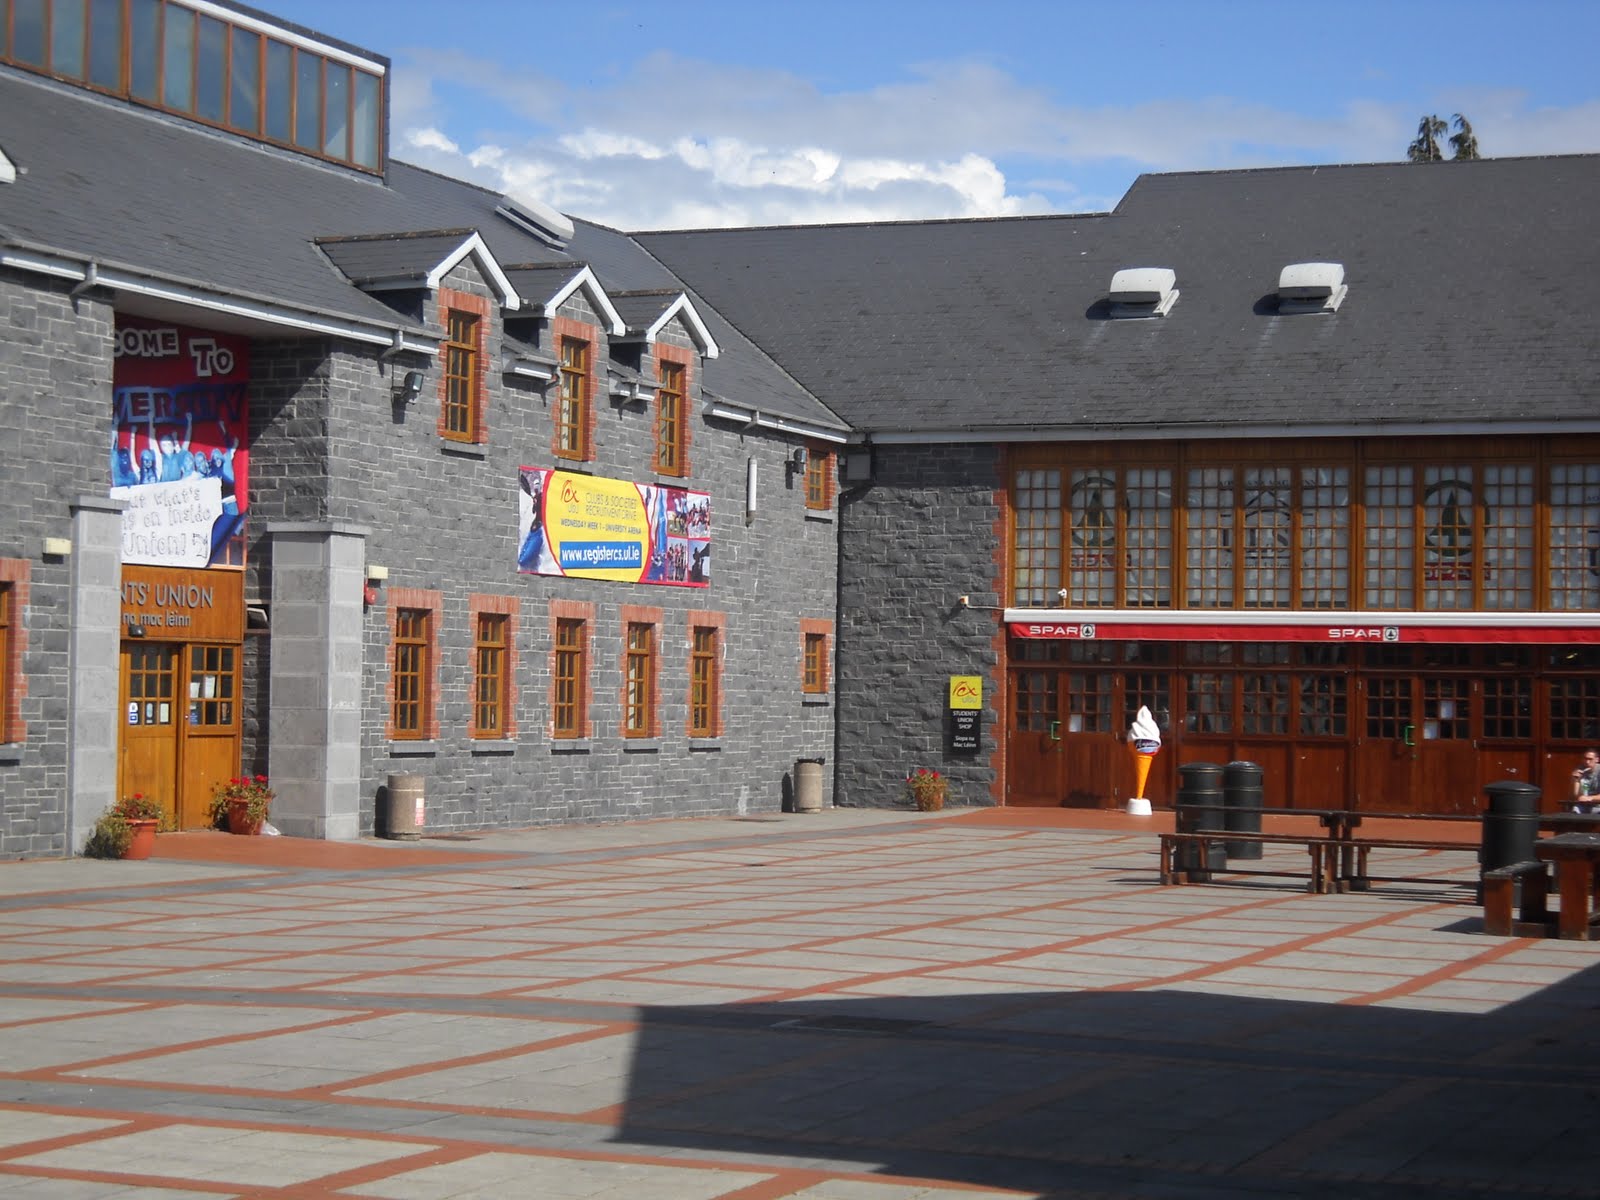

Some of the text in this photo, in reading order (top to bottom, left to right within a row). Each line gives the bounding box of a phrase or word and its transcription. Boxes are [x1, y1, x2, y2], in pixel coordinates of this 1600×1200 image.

[189, 338, 235, 377] TO
[561, 545, 640, 565] www.registercs.ul.ie
[155, 583, 214, 609] UNION
[140, 612, 163, 627] mac
[1029, 625, 1079, 636] SPAR
[1327, 628, 1381, 639] SPAR
